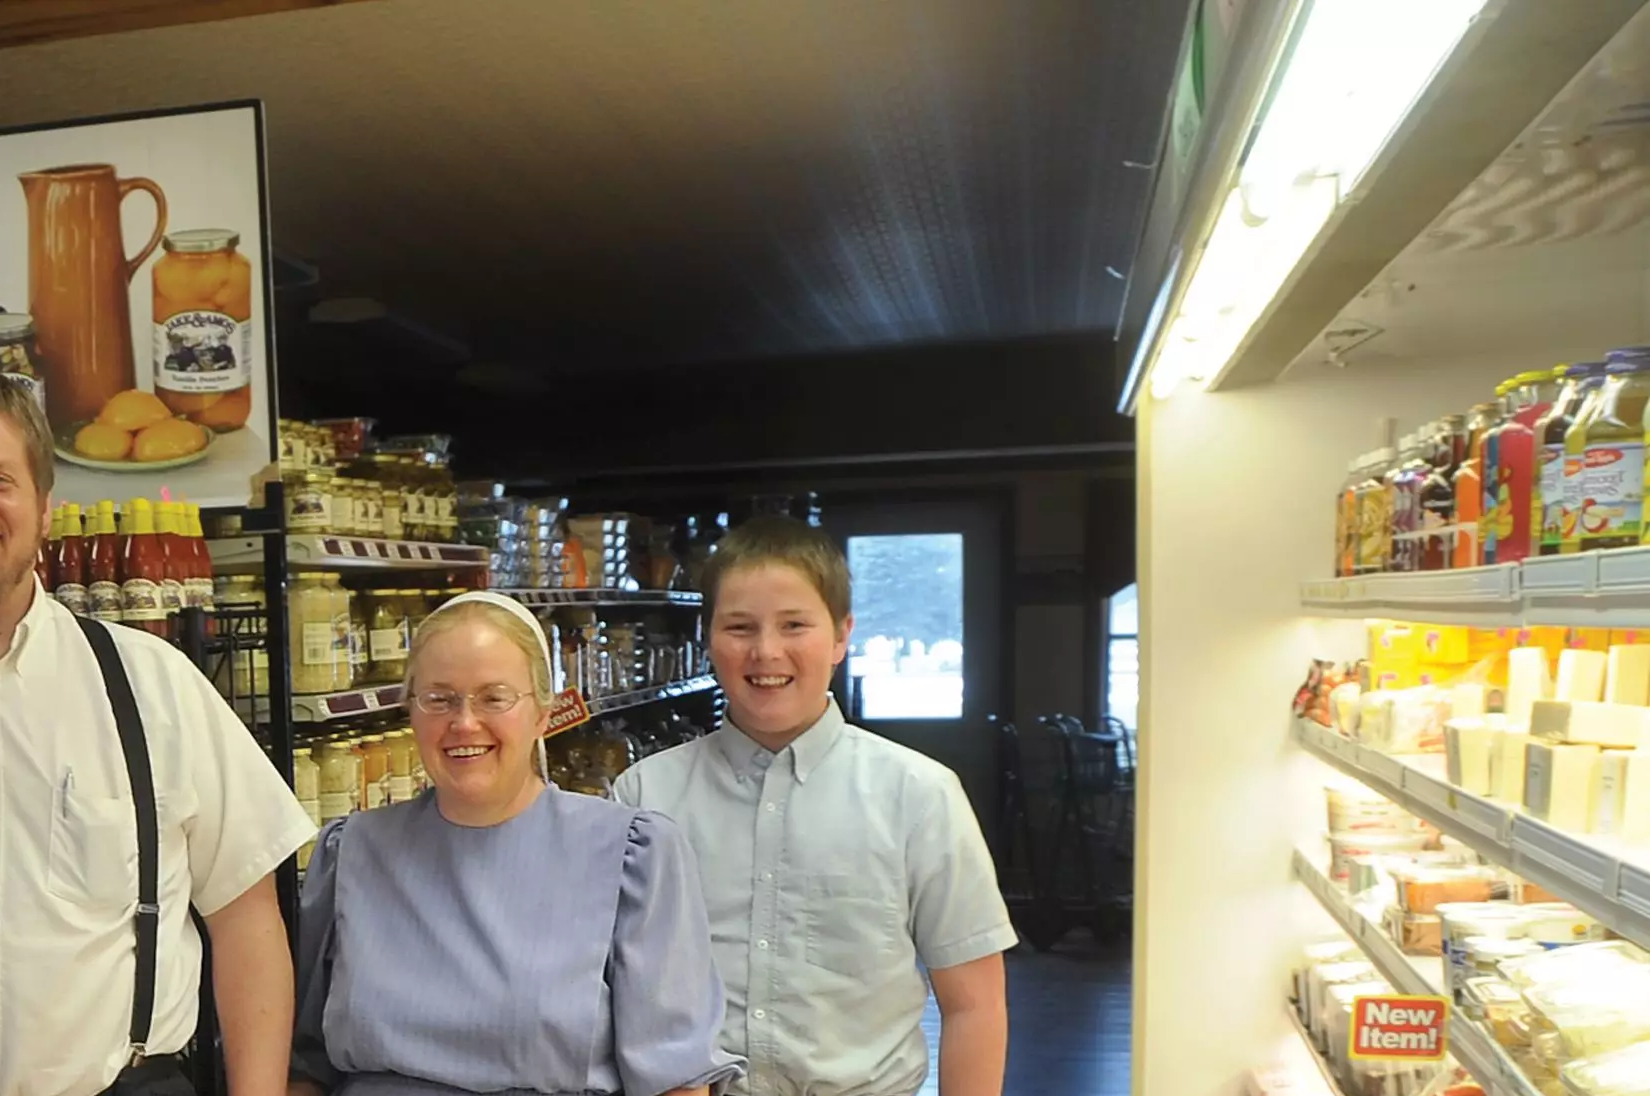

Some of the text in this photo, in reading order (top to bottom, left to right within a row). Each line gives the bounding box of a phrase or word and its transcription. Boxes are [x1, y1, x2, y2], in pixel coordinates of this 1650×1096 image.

[548, 704, 583, 728] tem!
[1365, 1001, 1437, 1026] New
[1359, 1025, 1438, 1050] Item!
